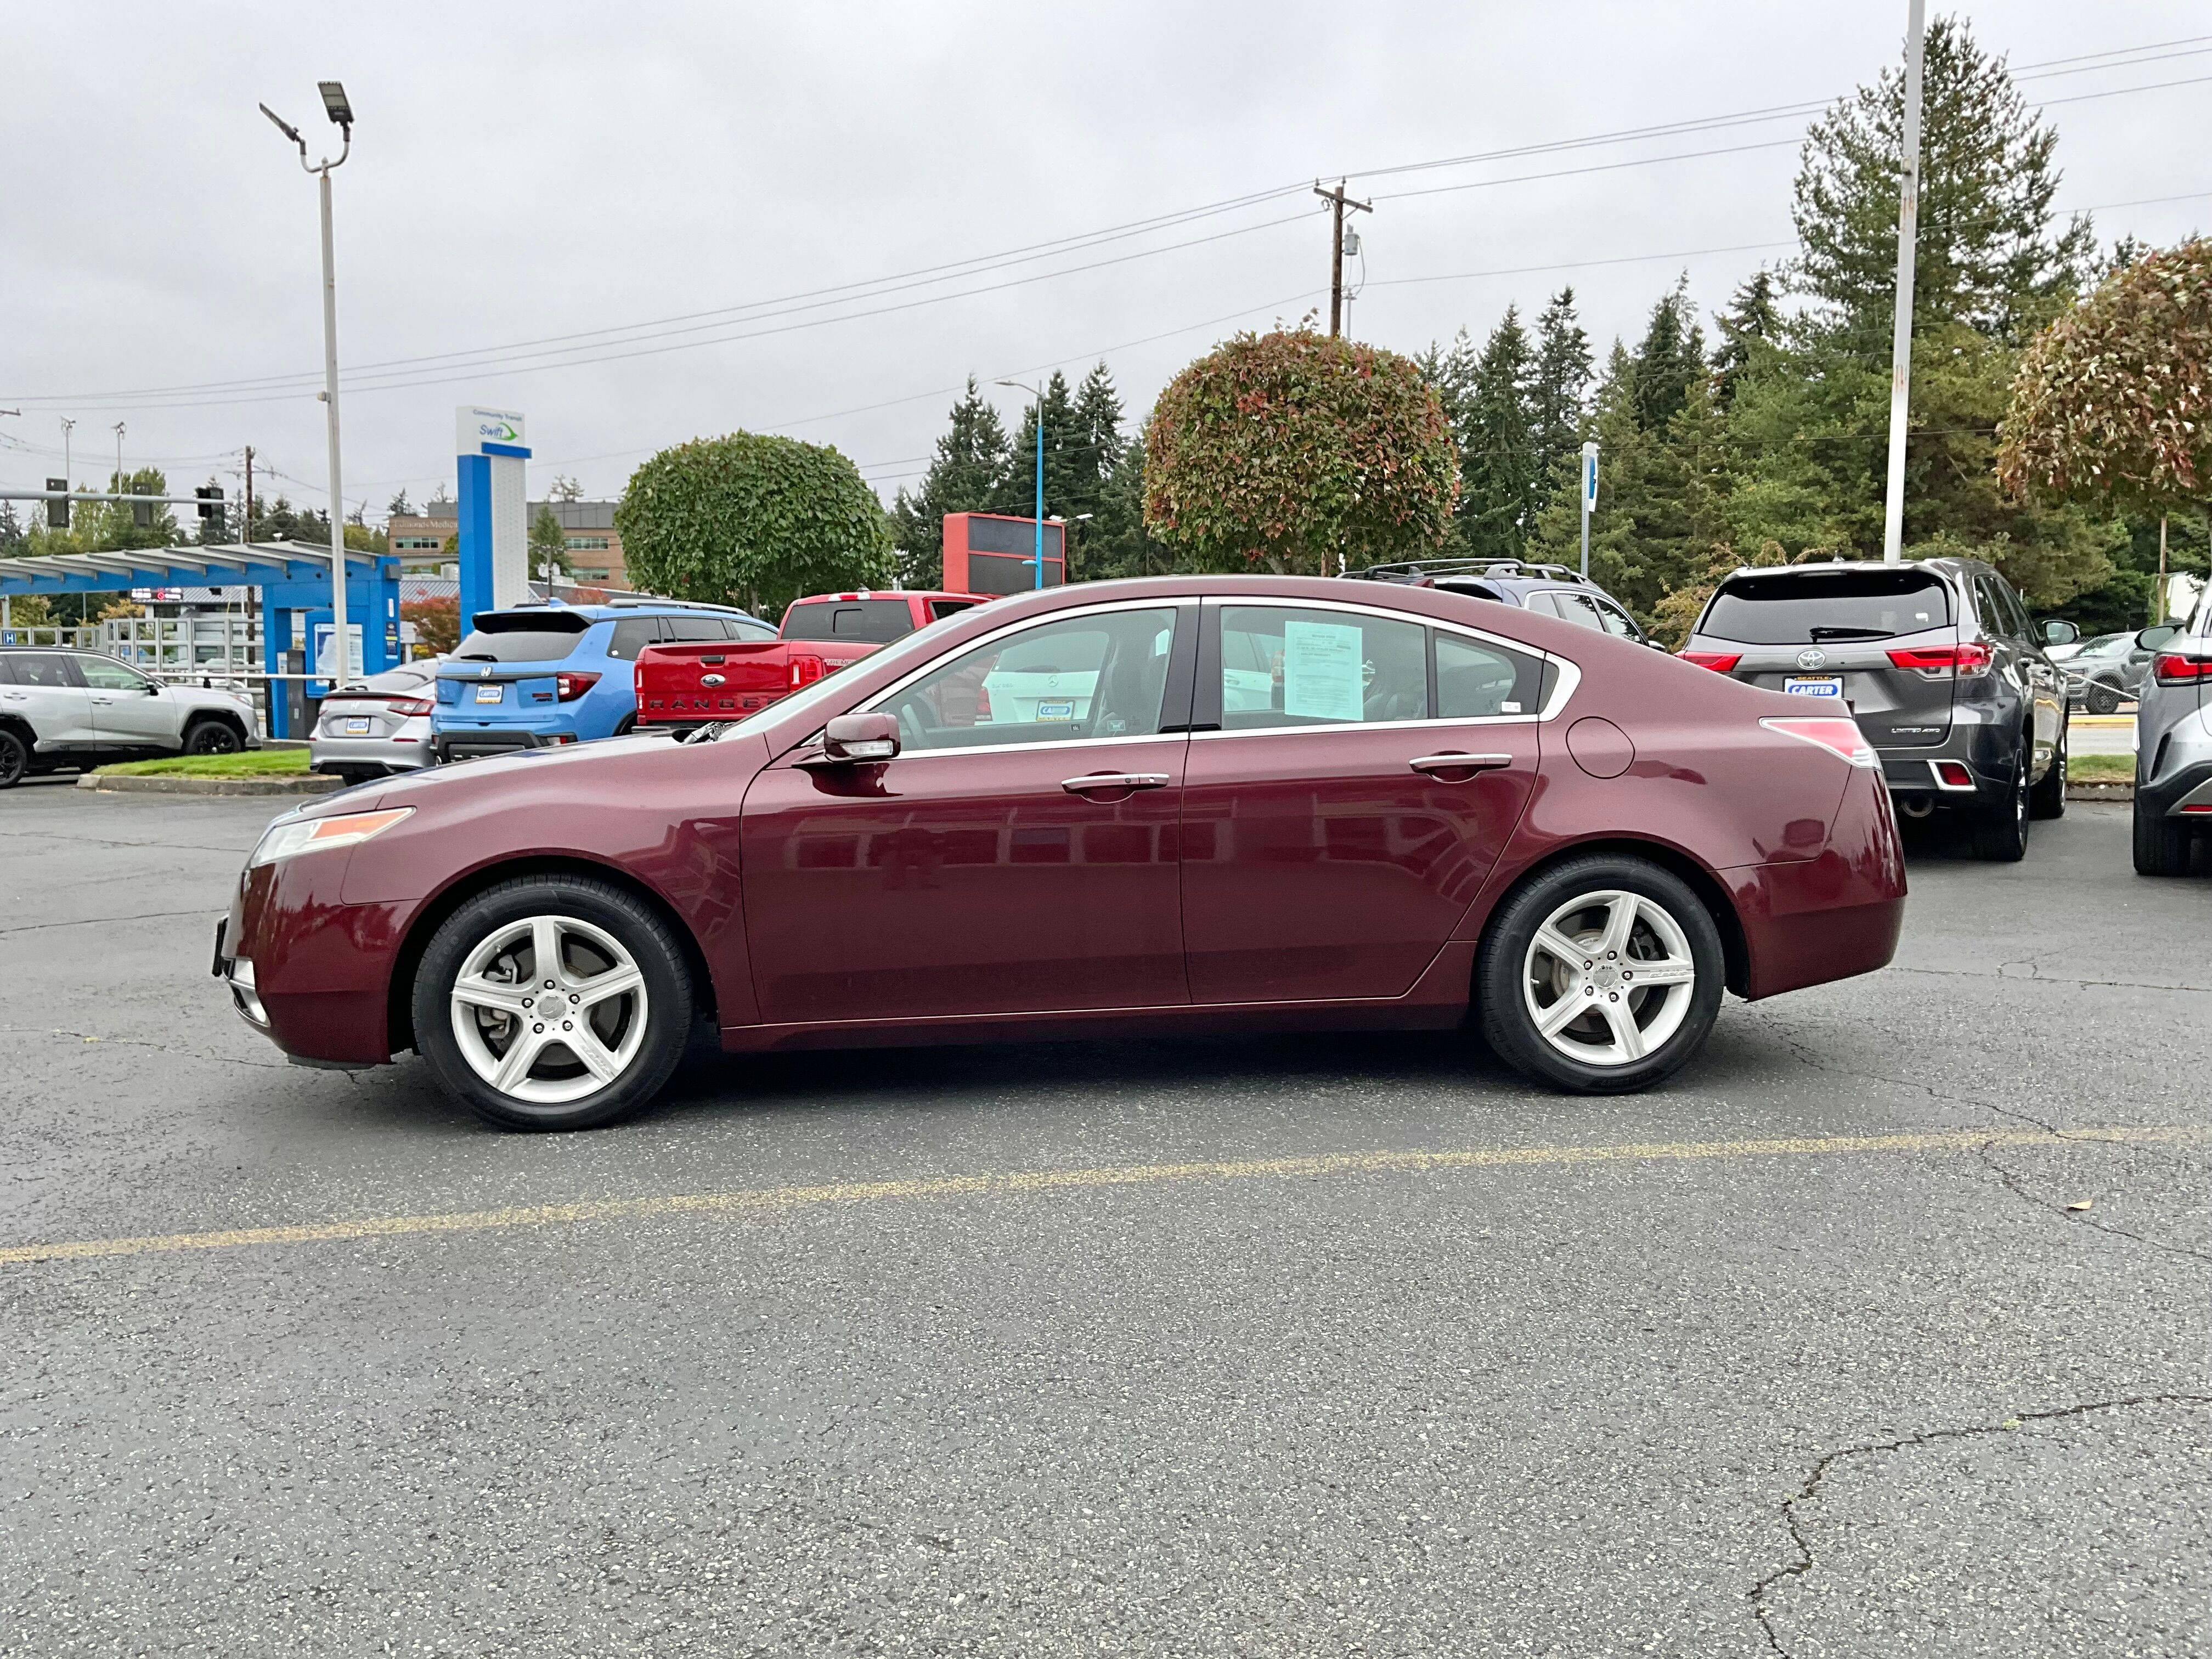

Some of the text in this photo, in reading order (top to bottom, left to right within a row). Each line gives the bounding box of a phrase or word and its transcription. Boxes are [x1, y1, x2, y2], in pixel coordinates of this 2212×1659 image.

[473, 409, 522, 422] Community Transit
[479, 424, 503, 437] Swift
[6, 633, 14, 642] H
[1791, 685, 1833, 695] CARTER
